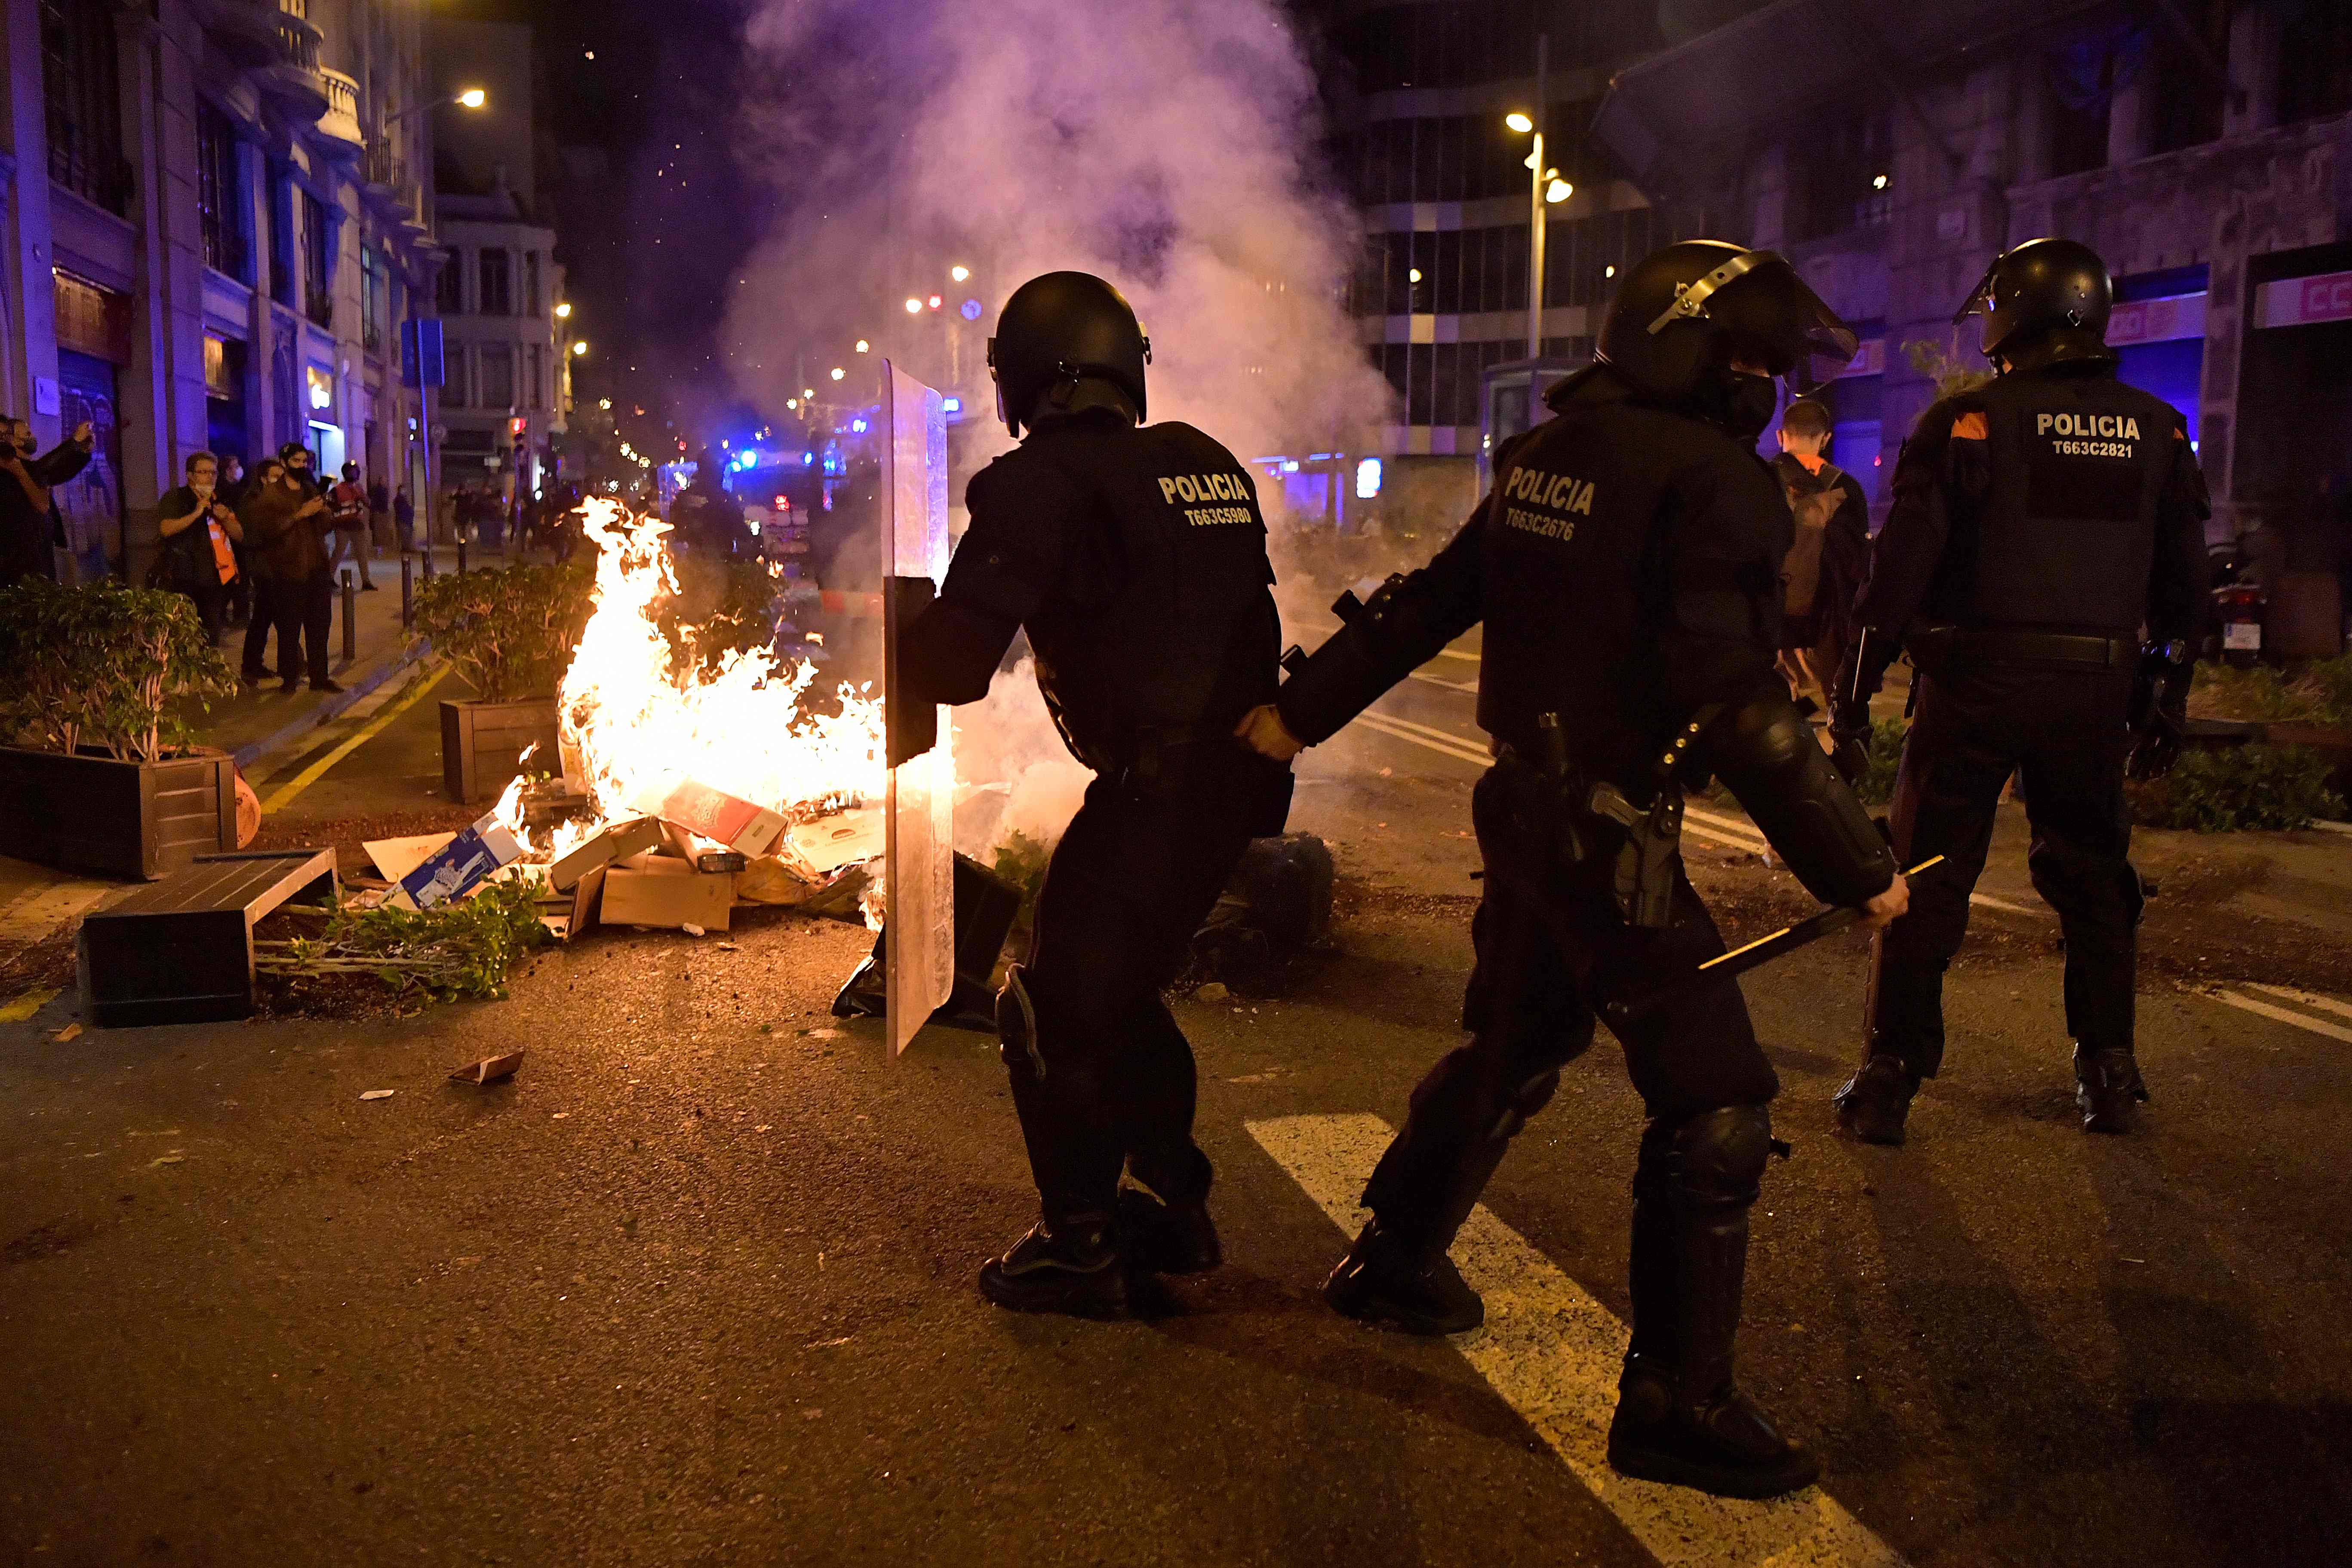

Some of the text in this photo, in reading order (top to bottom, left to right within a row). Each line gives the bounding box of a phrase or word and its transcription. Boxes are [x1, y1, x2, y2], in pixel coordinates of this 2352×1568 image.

[2037, 413, 2140, 440] POLICIA
[2052, 440, 2131, 458] T663C2821
[1157, 473, 1250, 504] POLICIA
[1505, 466, 1595, 516] POLICIA
[1184, 507, 1251, 526] T663C5980
[1506, 507, 1575, 541] T663C2676
